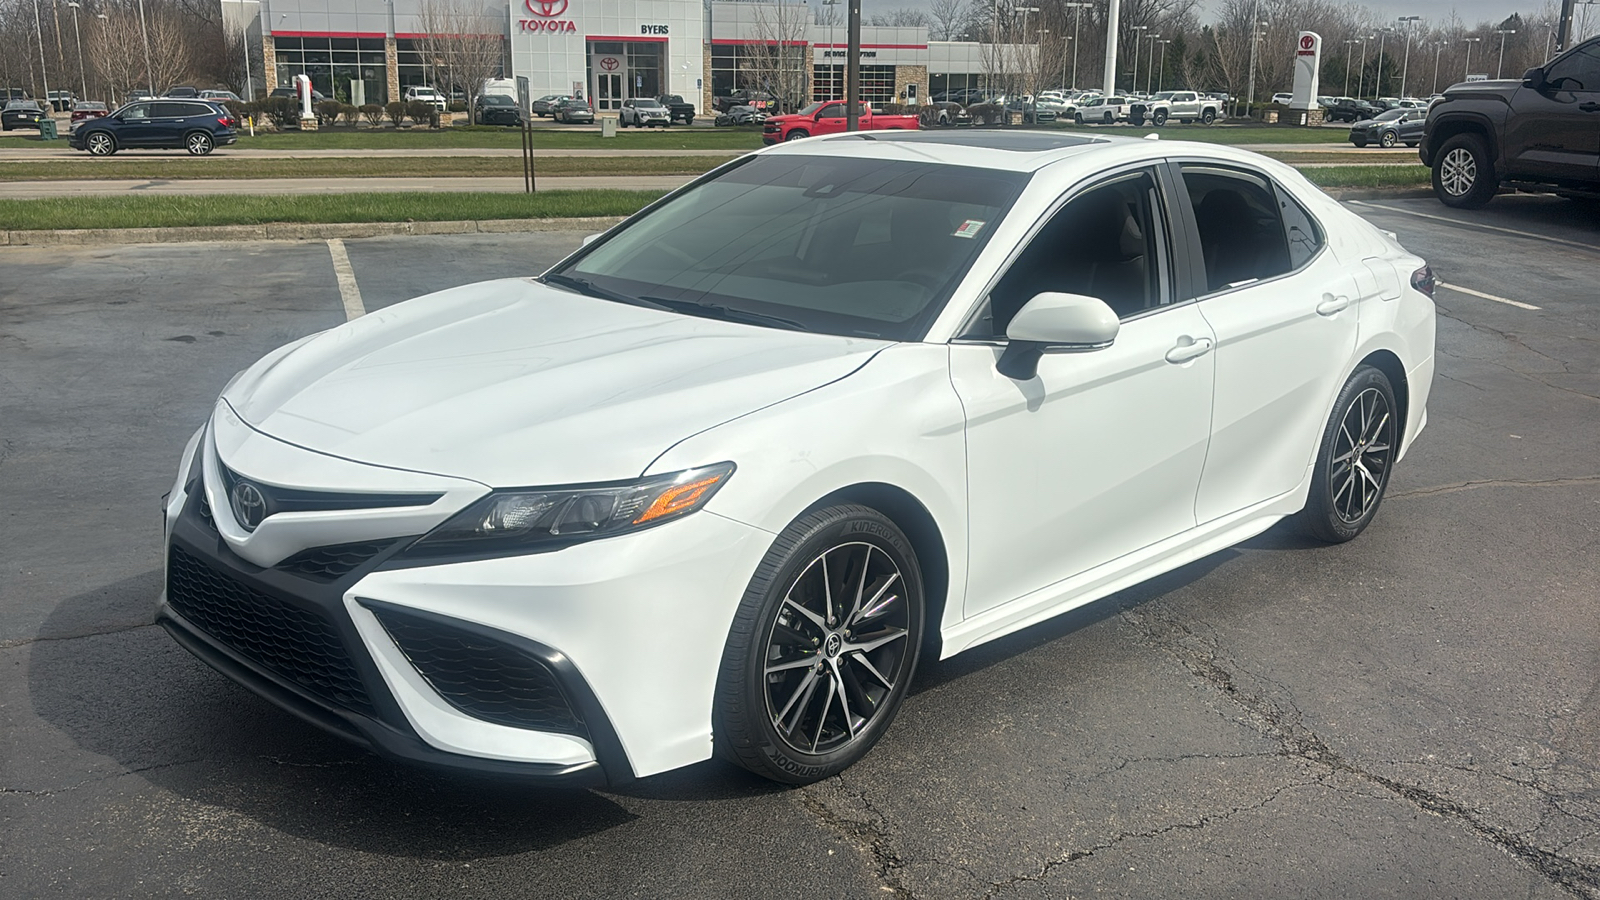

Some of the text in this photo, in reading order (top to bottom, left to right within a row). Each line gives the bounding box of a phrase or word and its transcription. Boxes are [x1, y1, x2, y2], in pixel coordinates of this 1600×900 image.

[519, 19, 577, 32] TOYOTA
[641, 24, 669, 34] BYERS
[851, 521, 896, 540] KINERGY
